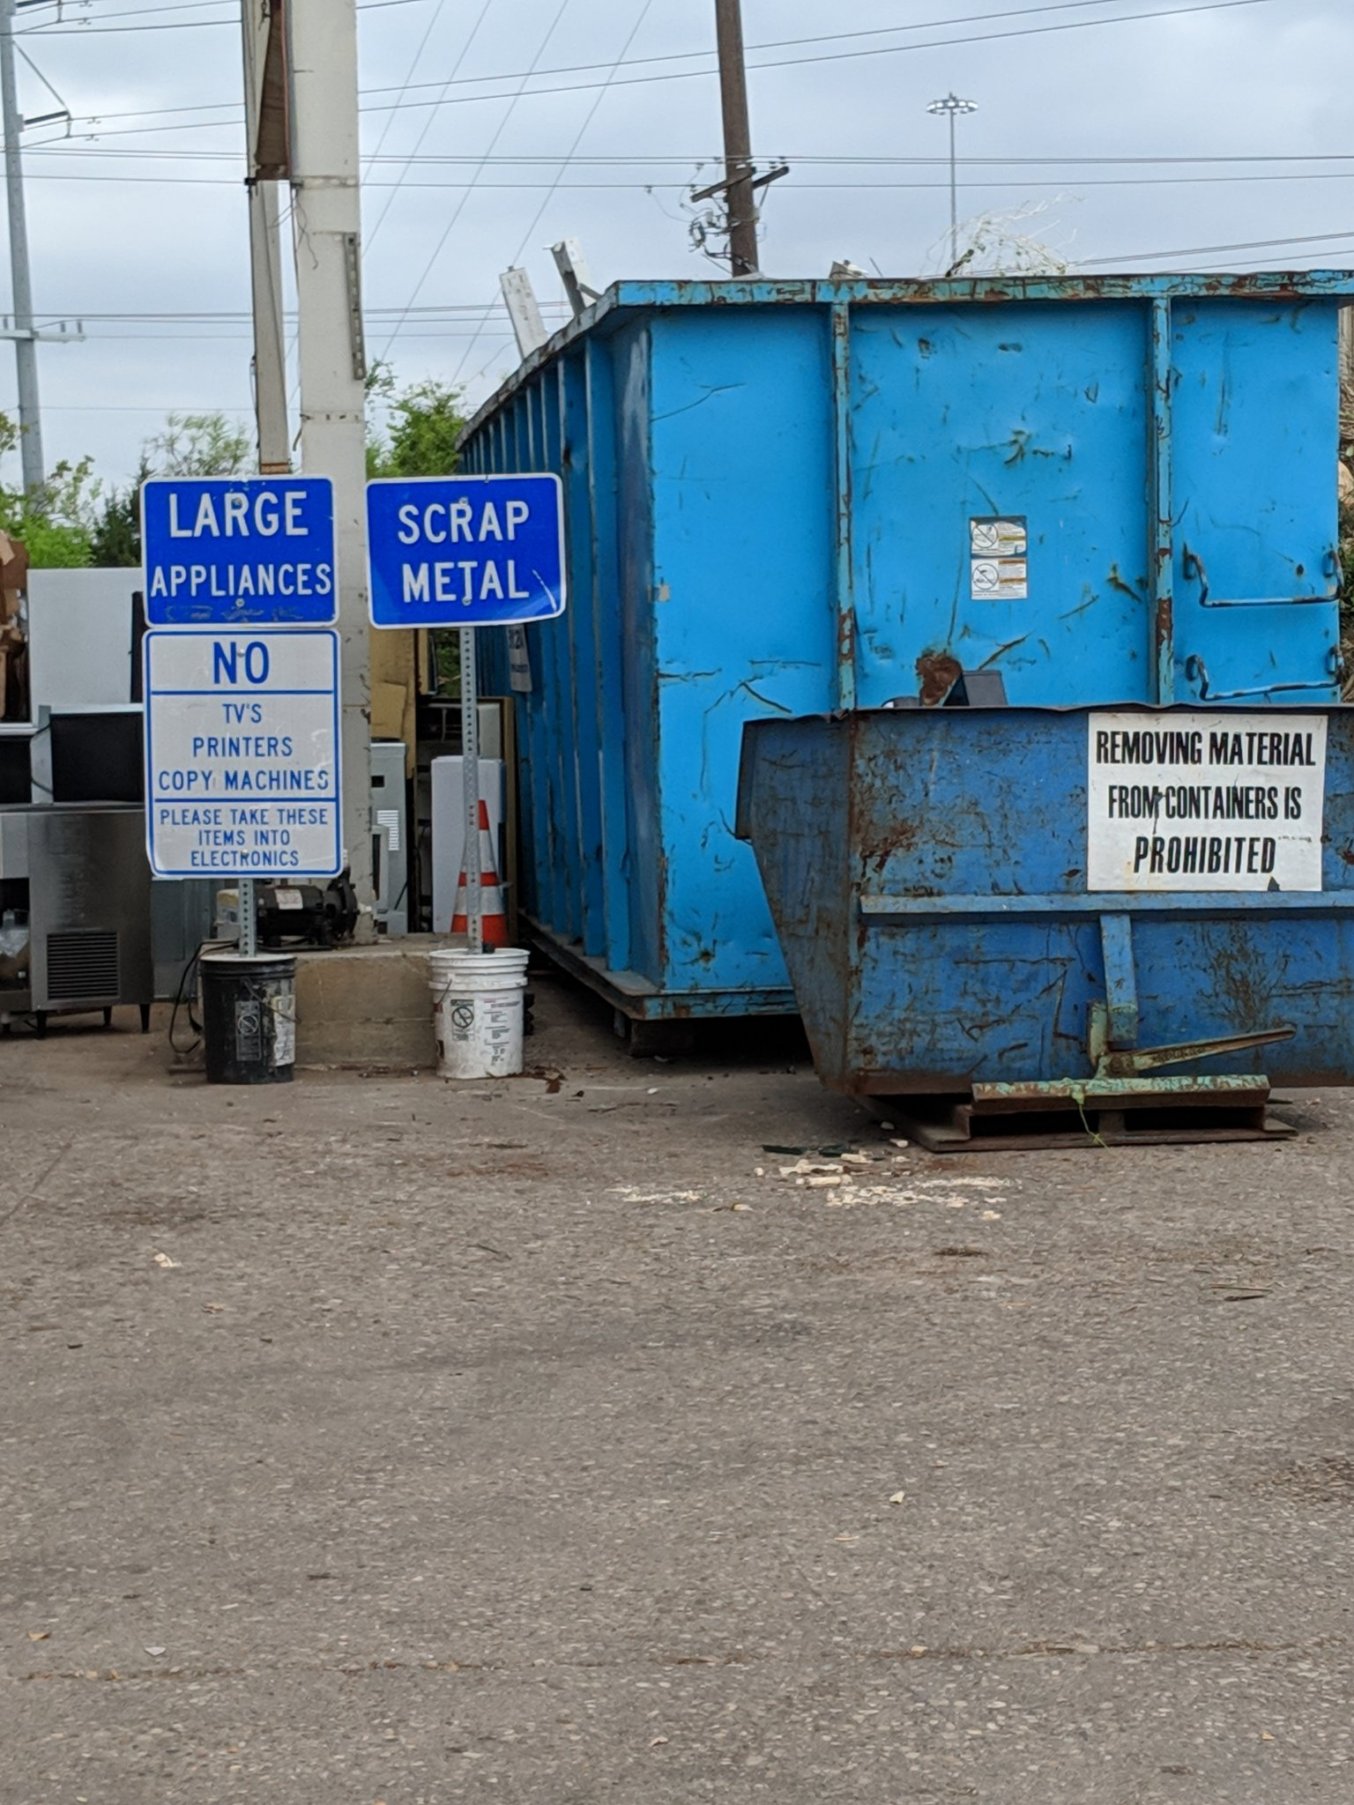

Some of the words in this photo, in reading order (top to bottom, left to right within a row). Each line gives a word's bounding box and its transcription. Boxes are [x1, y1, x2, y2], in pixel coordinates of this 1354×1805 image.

[169, 491, 309, 538] LARGE
[398, 500, 530, 545] SCRAP
[150, 563, 332, 598] APPLIANCES
[402, 559, 530, 603] METAL
[213, 641, 270, 685] NO
[222, 703, 262, 724] TV'S
[193, 736, 293, 757] PRINTERS
[1096, 730, 1203, 765] REMOVING
[1209, 731, 1316, 766] MATERIAL
[158, 770, 213, 791] COPY
[224, 770, 329, 790] MACHINES
[160, 809, 222, 826] PLEASE
[230, 808, 269, 825] TAKE
[277, 808, 328, 825] THESE
[1108, 785, 1160, 819] FROM
[1165, 785, 1278, 820] CONTAINERS
[1284, 786, 1302, 820] IS
[199, 829, 245, 846] ITEMS
[254, 829, 290, 846] INTO
[1133, 836, 1277, 874] PROHIBITED
[191, 850, 299, 867] ELECTRONICS
